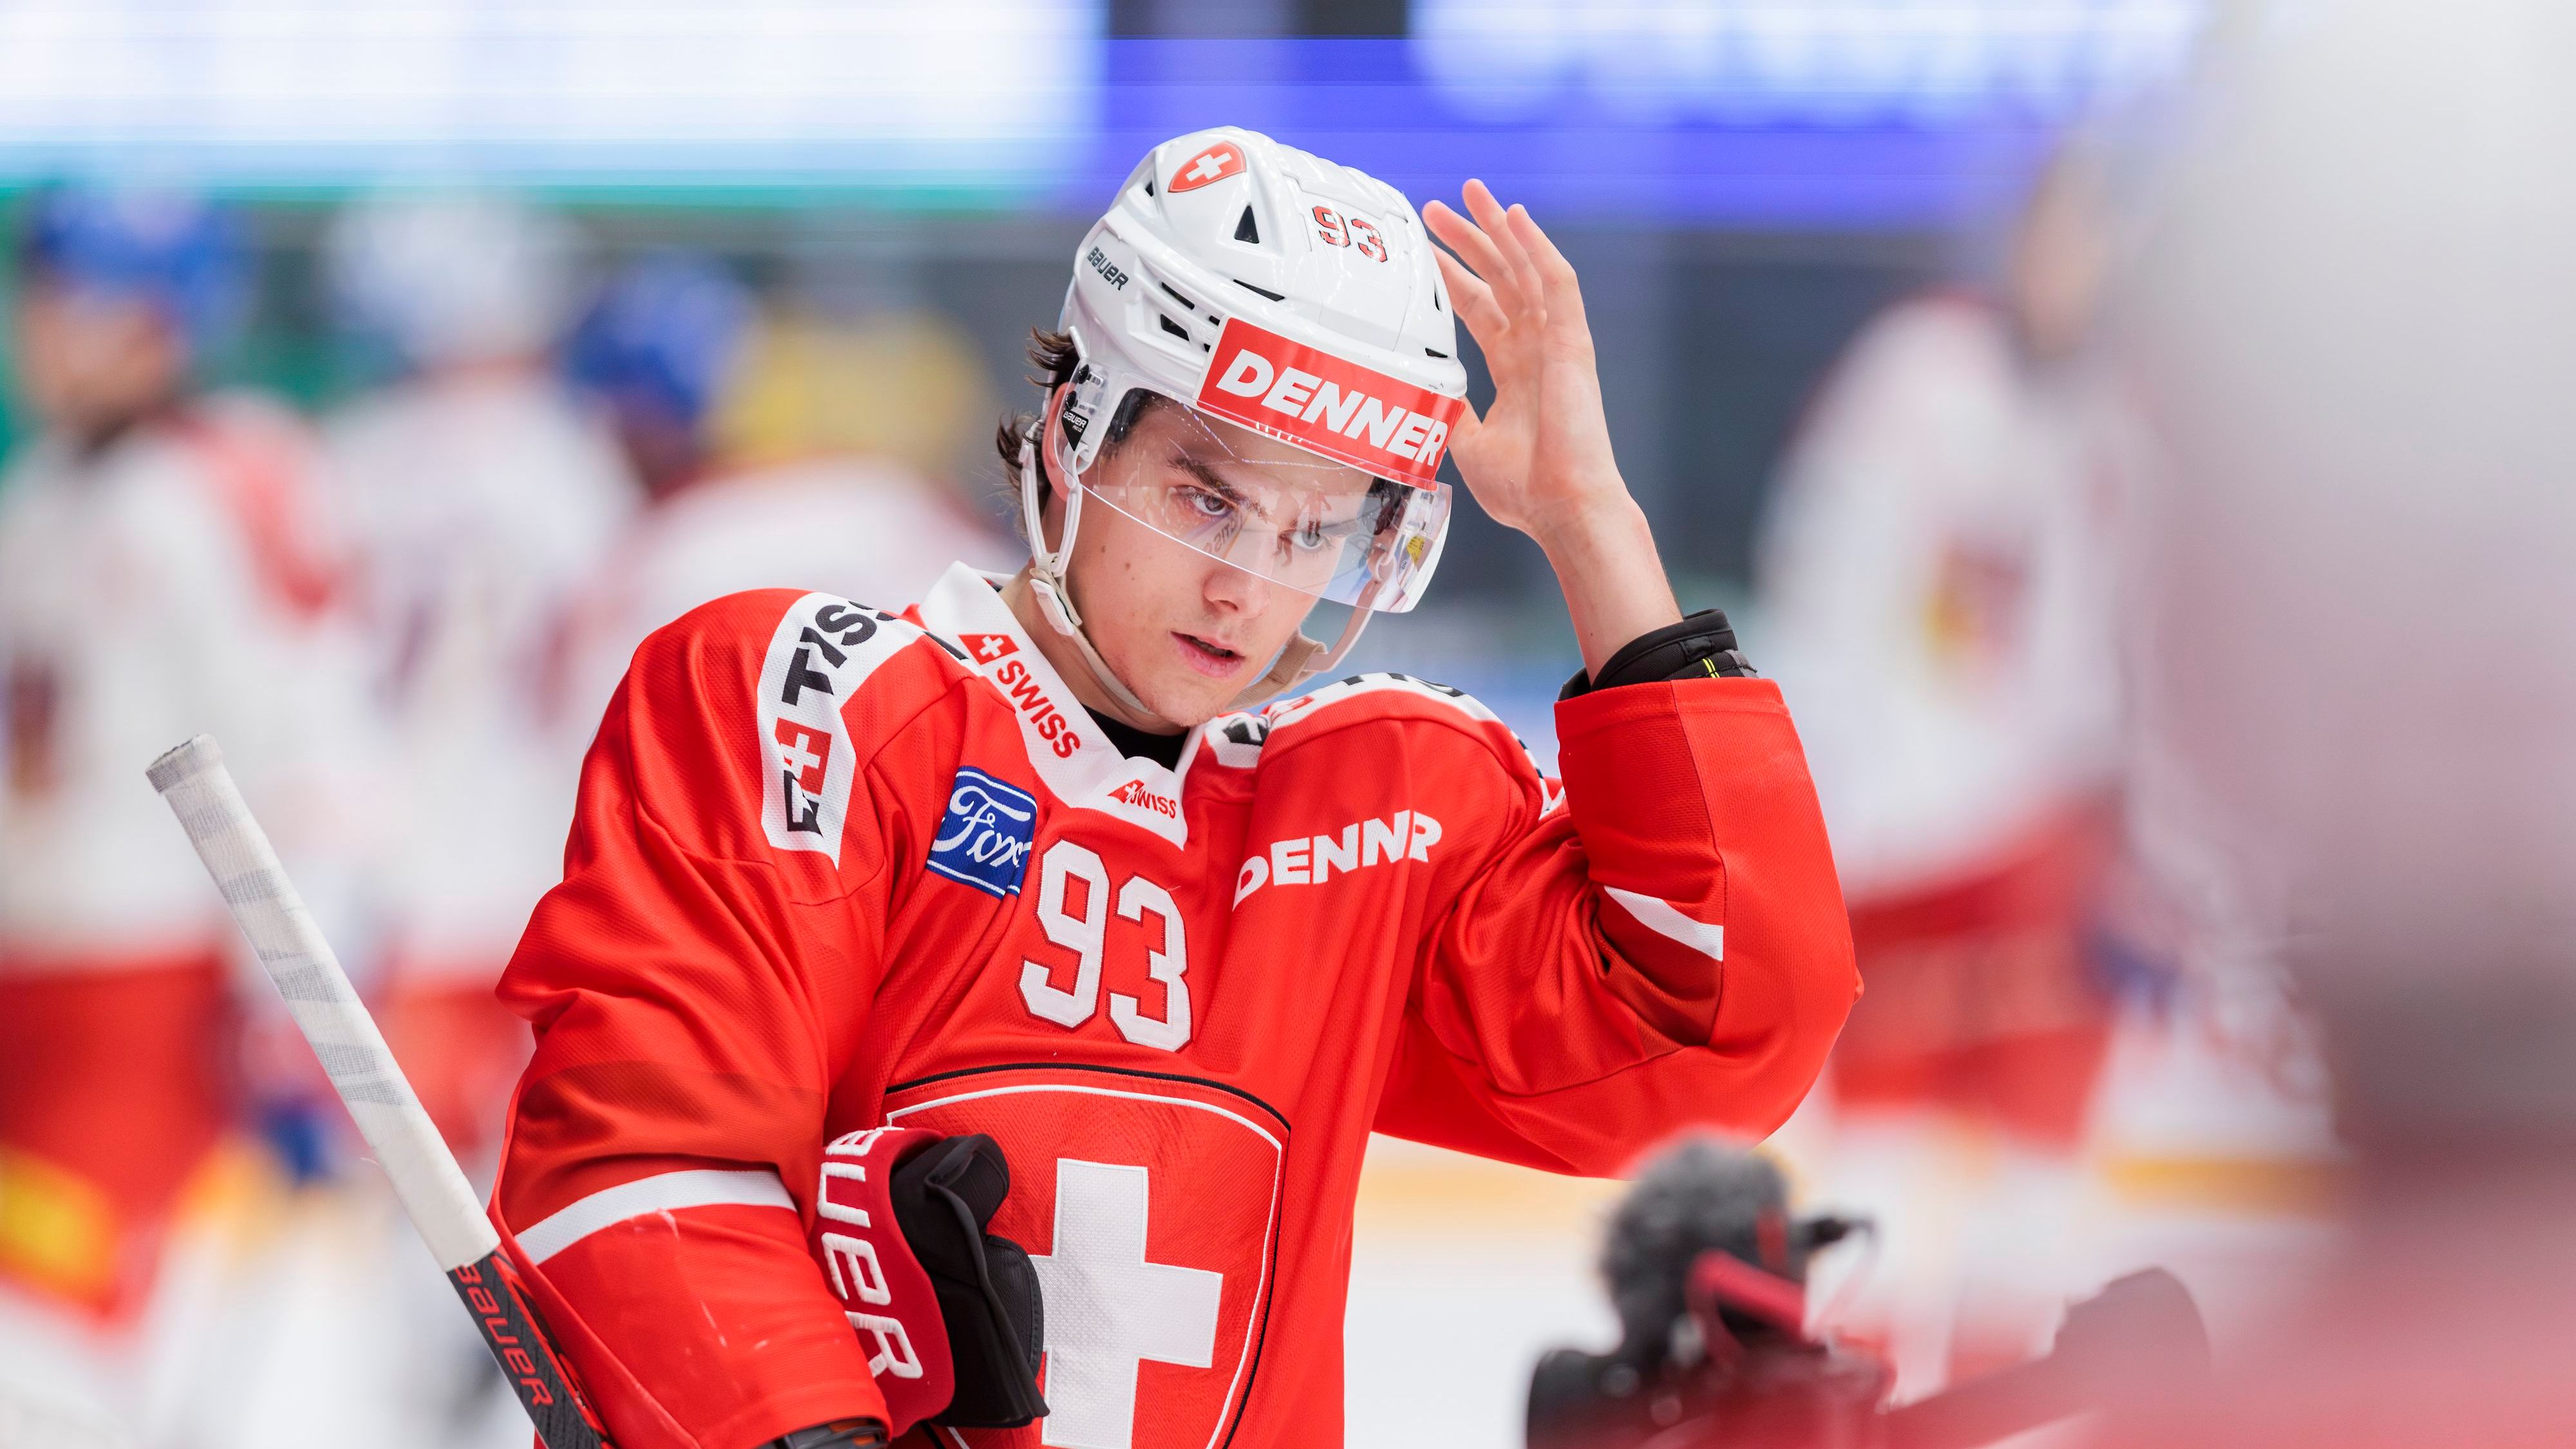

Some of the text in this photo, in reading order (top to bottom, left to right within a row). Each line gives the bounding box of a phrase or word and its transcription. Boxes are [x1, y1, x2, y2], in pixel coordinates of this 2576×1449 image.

[1087, 245, 1129, 291] BAUER
[1312, 205, 1388, 263] 93
[1063, 411, 1087, 428] BAUER
[1216, 348, 1448, 466] DENNER
[997, 659, 1081, 759] SWISS
[1014, 837, 1193, 1053] 93
[455, 1263, 554, 1406] BAUER
